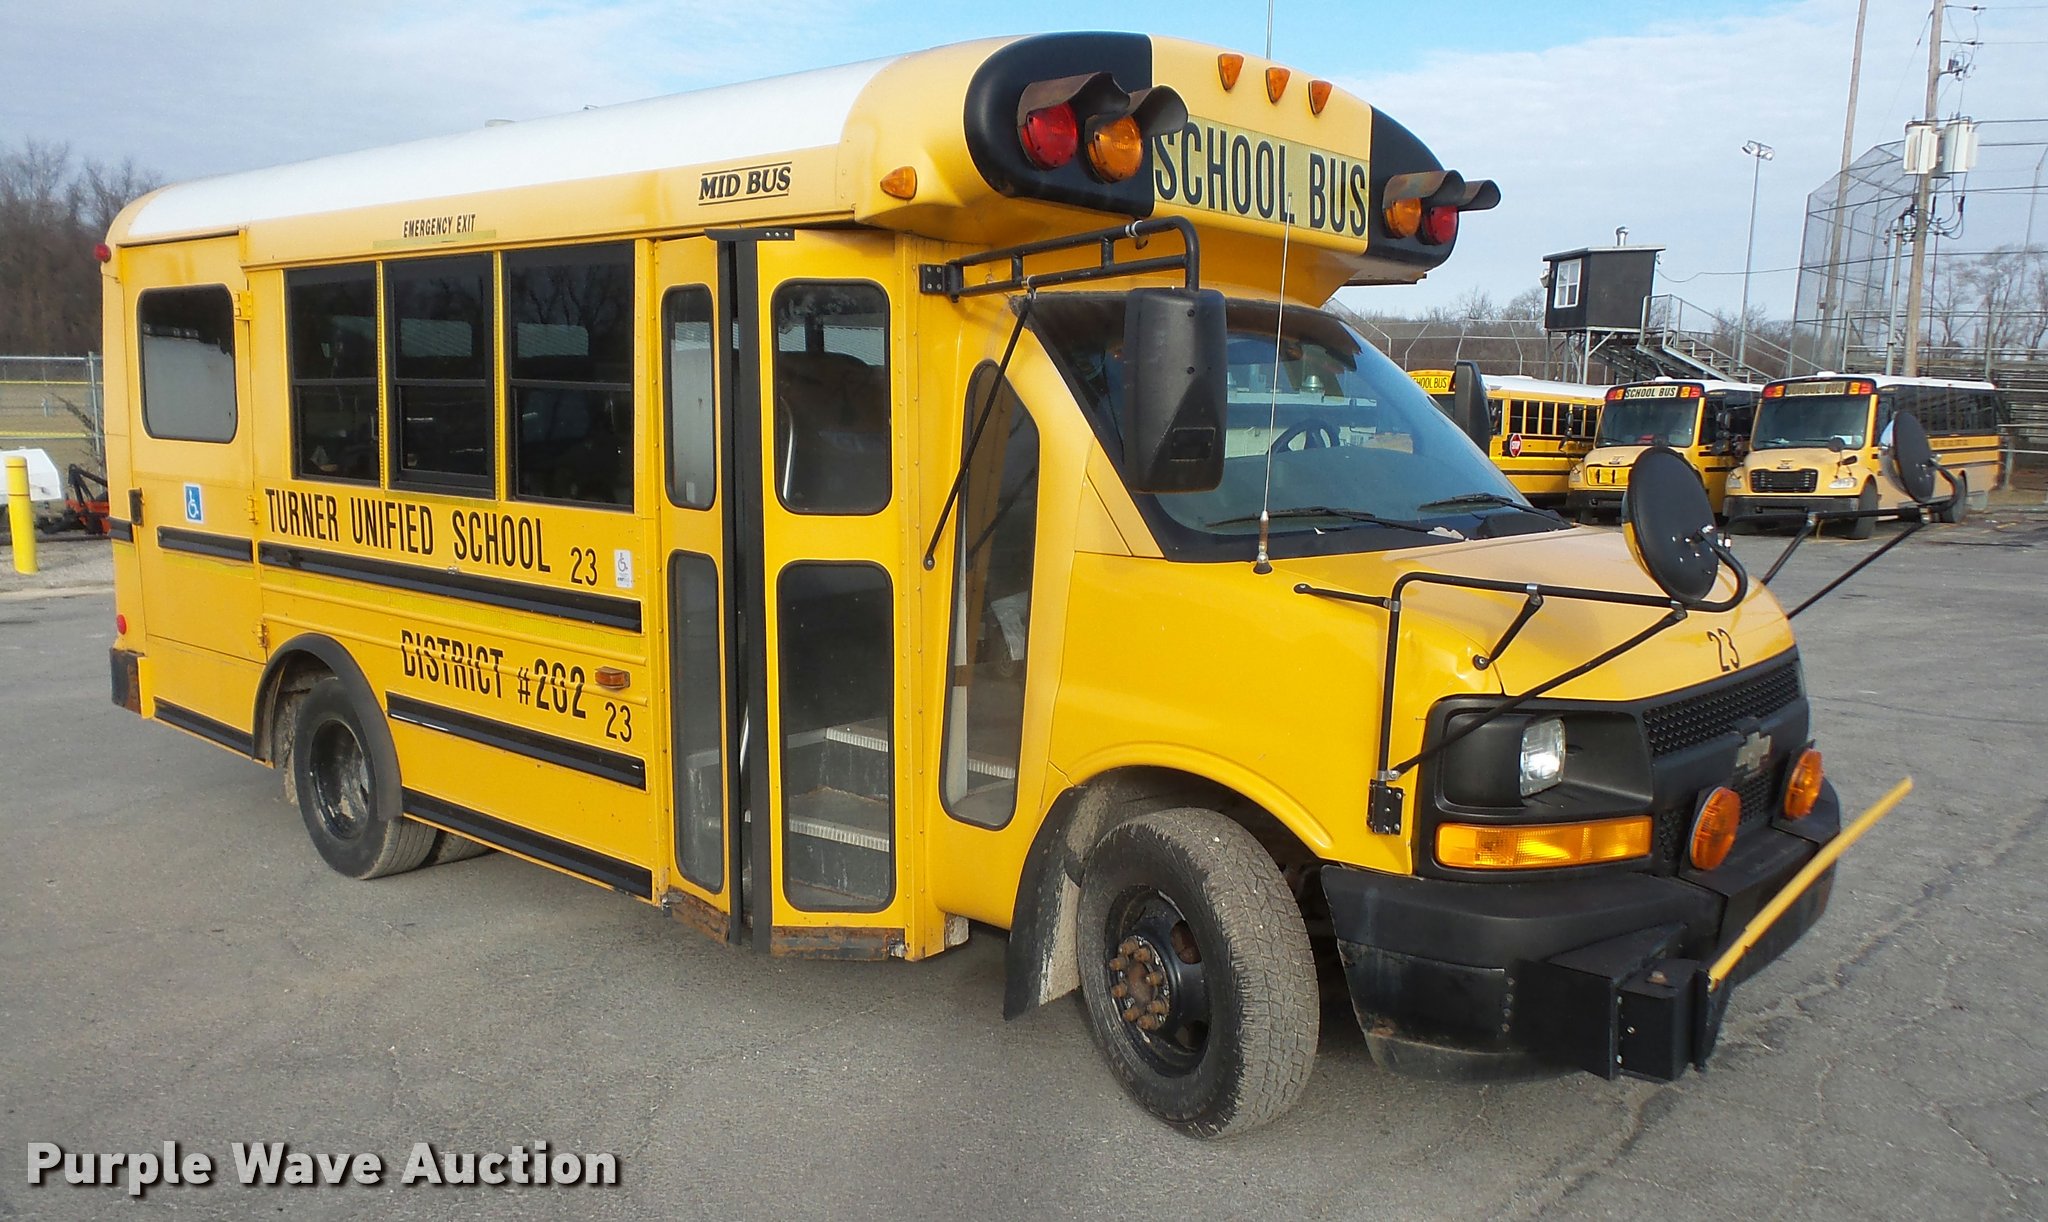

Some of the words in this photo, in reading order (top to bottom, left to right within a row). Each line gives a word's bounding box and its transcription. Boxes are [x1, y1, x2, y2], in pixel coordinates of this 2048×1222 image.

[699, 174, 741, 200] MID
[746, 166, 791, 194] BUS
[1154, 122, 1294, 224] SCHOOL
[1310, 153, 1366, 237] BUS
[403, 216, 453, 238] EMERGENCY
[457, 214, 475, 233] EXIT
[1434, 377, 1447, 388] BUS
[1625, 387, 1655, 398] SCHOOL
[1659, 387, 1676, 396] BUS
[265, 488, 339, 542] TURNER
[350, 496, 434, 555] UNIFIED
[452, 510, 551, 573] SCHOOL
[570, 546, 598, 586] 23
[1706, 628, 1740, 672] 23
[401, 629, 503, 699] DISTRICT
[517, 658, 587, 719] #202
[605, 701, 632, 743] 23
